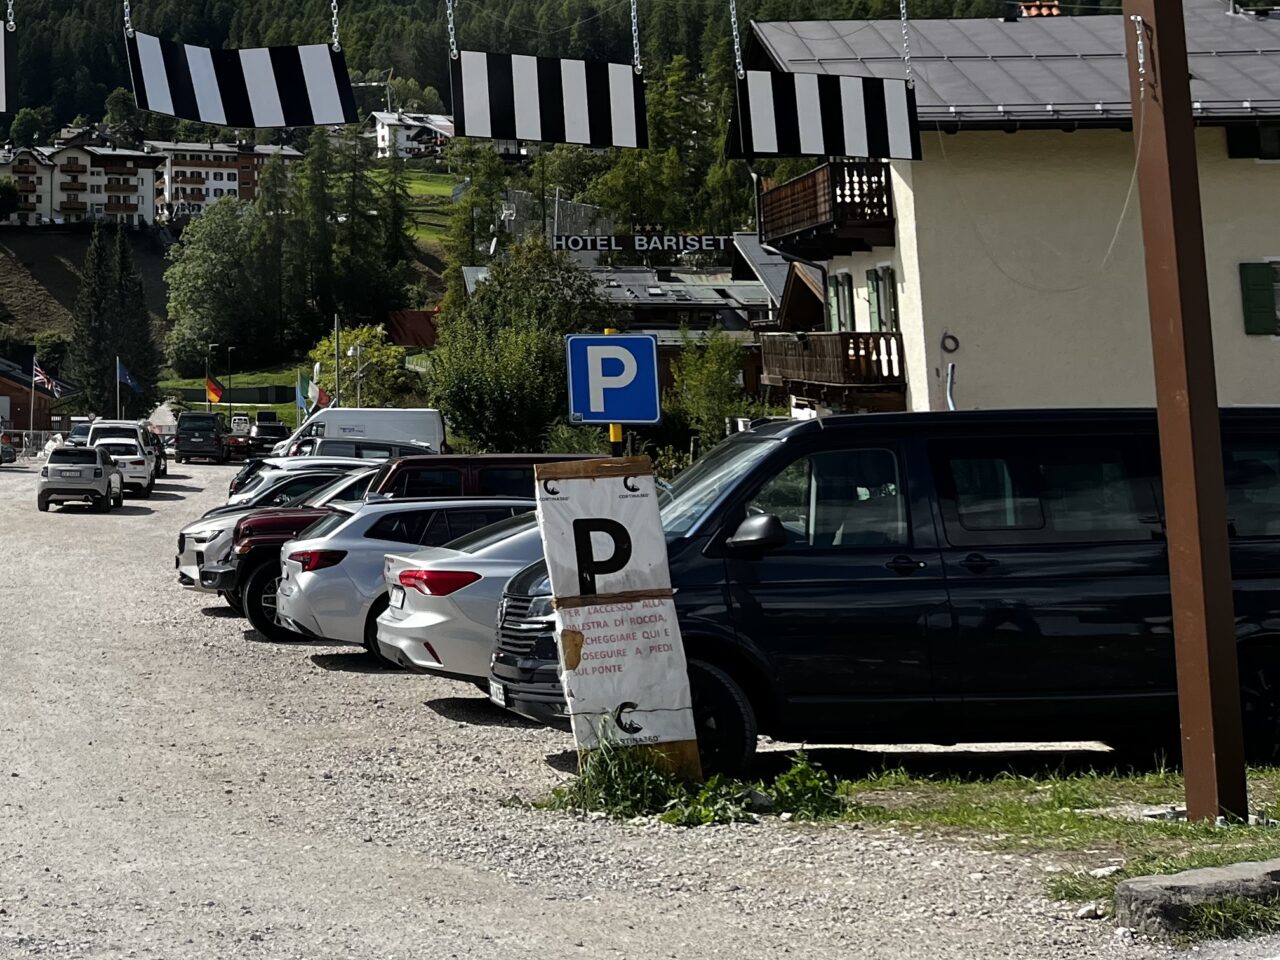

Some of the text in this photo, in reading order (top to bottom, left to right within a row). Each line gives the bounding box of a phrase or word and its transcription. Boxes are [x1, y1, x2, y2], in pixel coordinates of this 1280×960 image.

[553, 235, 623, 251] HOTEL
[587, 345, 637, 413] P
[573, 518, 632, 595] P
[564, 608, 581, 618] PER
[642, 599, 665, 609] ALLA
[566, 614, 668, 631] PALESTRA DI ROCCIA,
[583, 628, 671, 646] CHEGGIARE QUI E
[581, 643, 673, 661] OSEGUIRE A PIEDI
[573, 664, 624, 677] SUL PONTE
